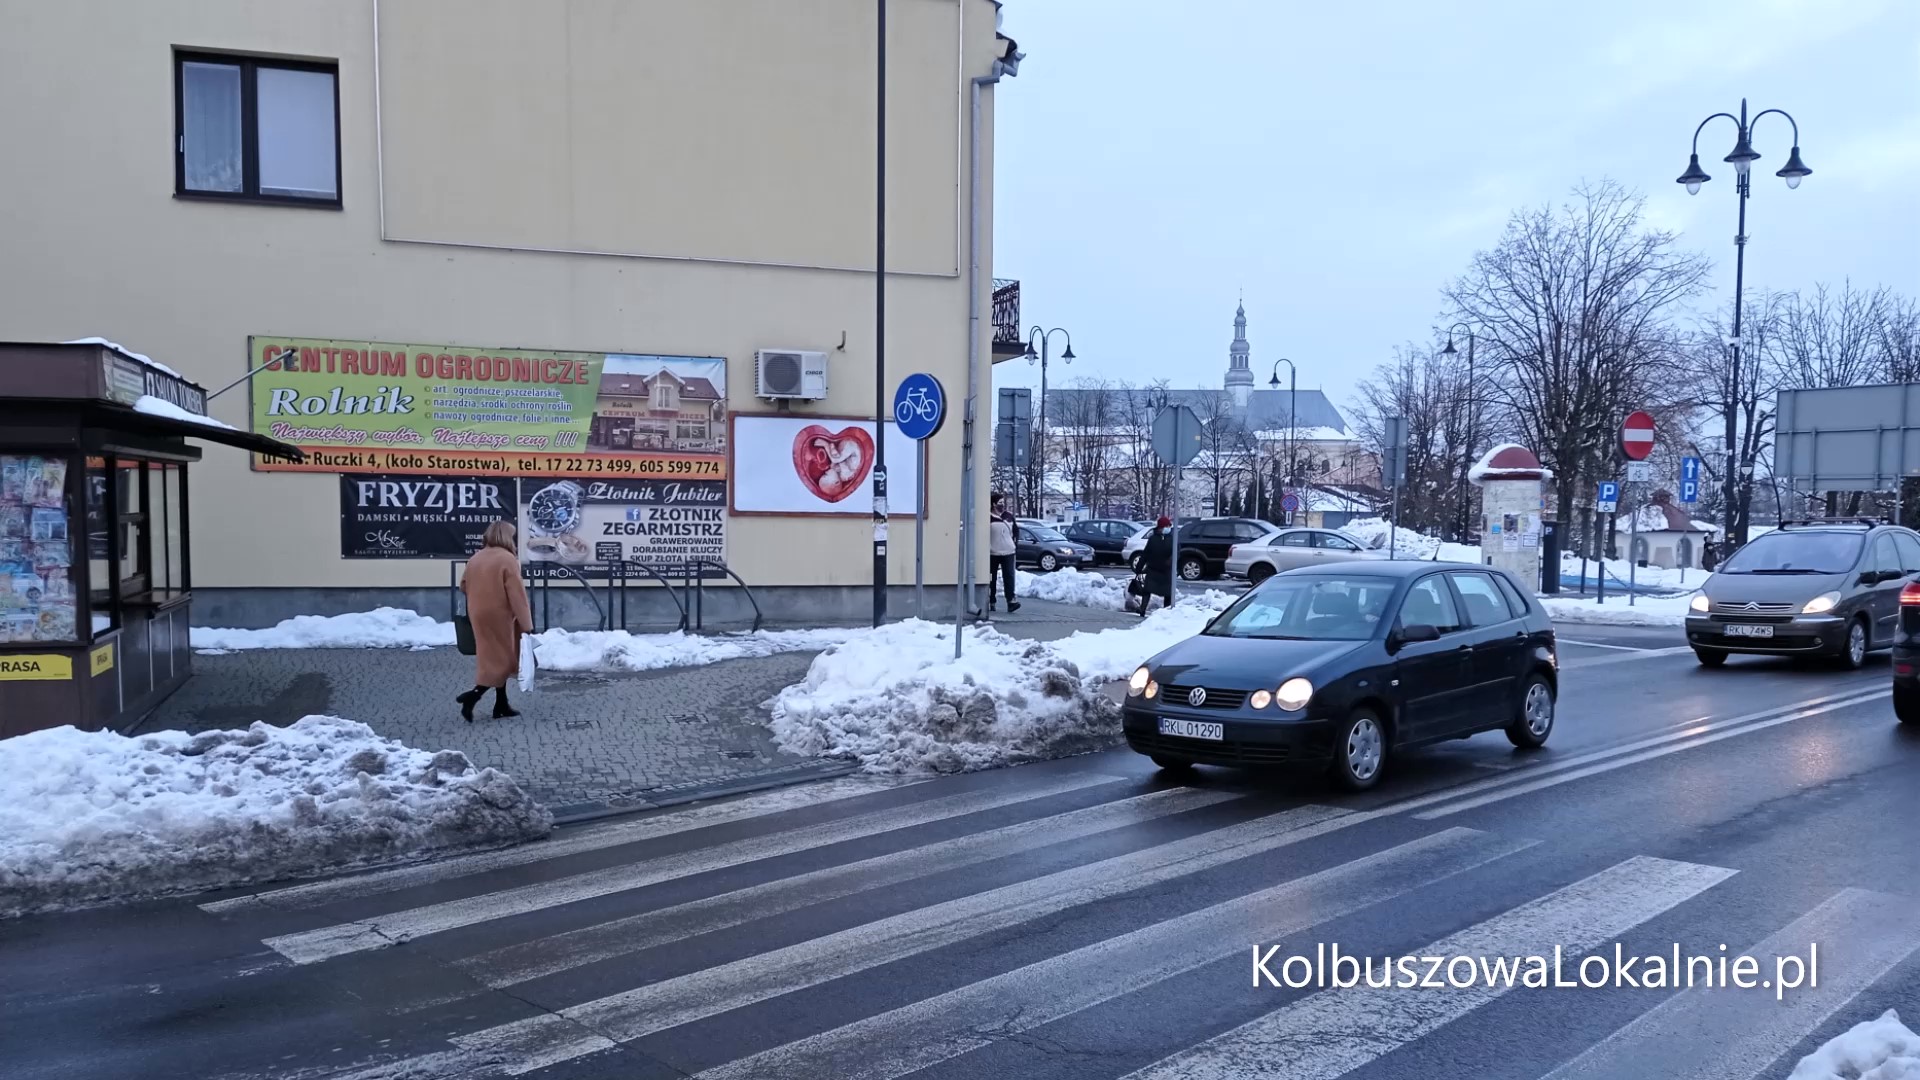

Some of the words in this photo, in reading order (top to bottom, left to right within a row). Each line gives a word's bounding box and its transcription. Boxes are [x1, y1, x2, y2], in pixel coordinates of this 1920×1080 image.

[262, 344, 406, 377] CENTRUM
[415, 353, 589, 384] OGRODNICZE
[453, 386, 502, 397] ogrodnicze,
[505, 388, 563, 399] pszczelarskie,
[266, 385, 415, 416] Rolnik
[433, 399, 479, 409] narzędzia,
[511, 401, 544, 411] ochrony
[548, 401, 572, 411] roślin
[433, 413, 467, 422] nawozy
[471, 413, 520, 423] ogrodnicze,
[523, 413, 542, 422] folie
[271, 422, 368, 444] Największy
[433, 428, 510, 449] Najlepsze
[515, 434, 548, 449] ceny
[313, 452, 362, 467] Ruczki
[367, 454, 381, 469] 4,
[385, 453, 423, 469] (koło
[427, 454, 510, 472] Starostwa),
[518, 458, 541, 471] tel.
[547, 458, 563, 471] 17
[566, 459, 583, 472] 22
[587, 459, 603, 472] 73
[607, 460, 636, 474] 499,
[639, 460, 665, 473] 605
[667, 460, 692, 473] 599
[695, 461, 719, 474] 774
[357, 481, 502, 514] FRYZJER
[586, 482, 656, 500] Złotnik
[663, 483, 723, 504] Jubiler
[1603, 485, 1615, 499] P
[1684, 484, 1695, 499] P
[357, 514, 400, 522] DAMSKI
[413, 514, 448, 524] MĘSKI
[649, 508, 722, 521] ZŁOTNIK
[602, 522, 723, 536] ZEGARMISTRZ
[650, 537, 723, 545] GRAWEROWANIE
[632, 546, 688, 554] DORABIANIE
[690, 546, 723, 554] KLUCZY
[630, 555, 653, 563] SKUP
[655, 555, 683, 563] ZŁOTA
[1727, 625, 1746, 636] RKL
[0, 661, 41, 672] RASA
[1164, 719, 1183, 734] RKL
[1186, 722, 1222, 739] 01290
